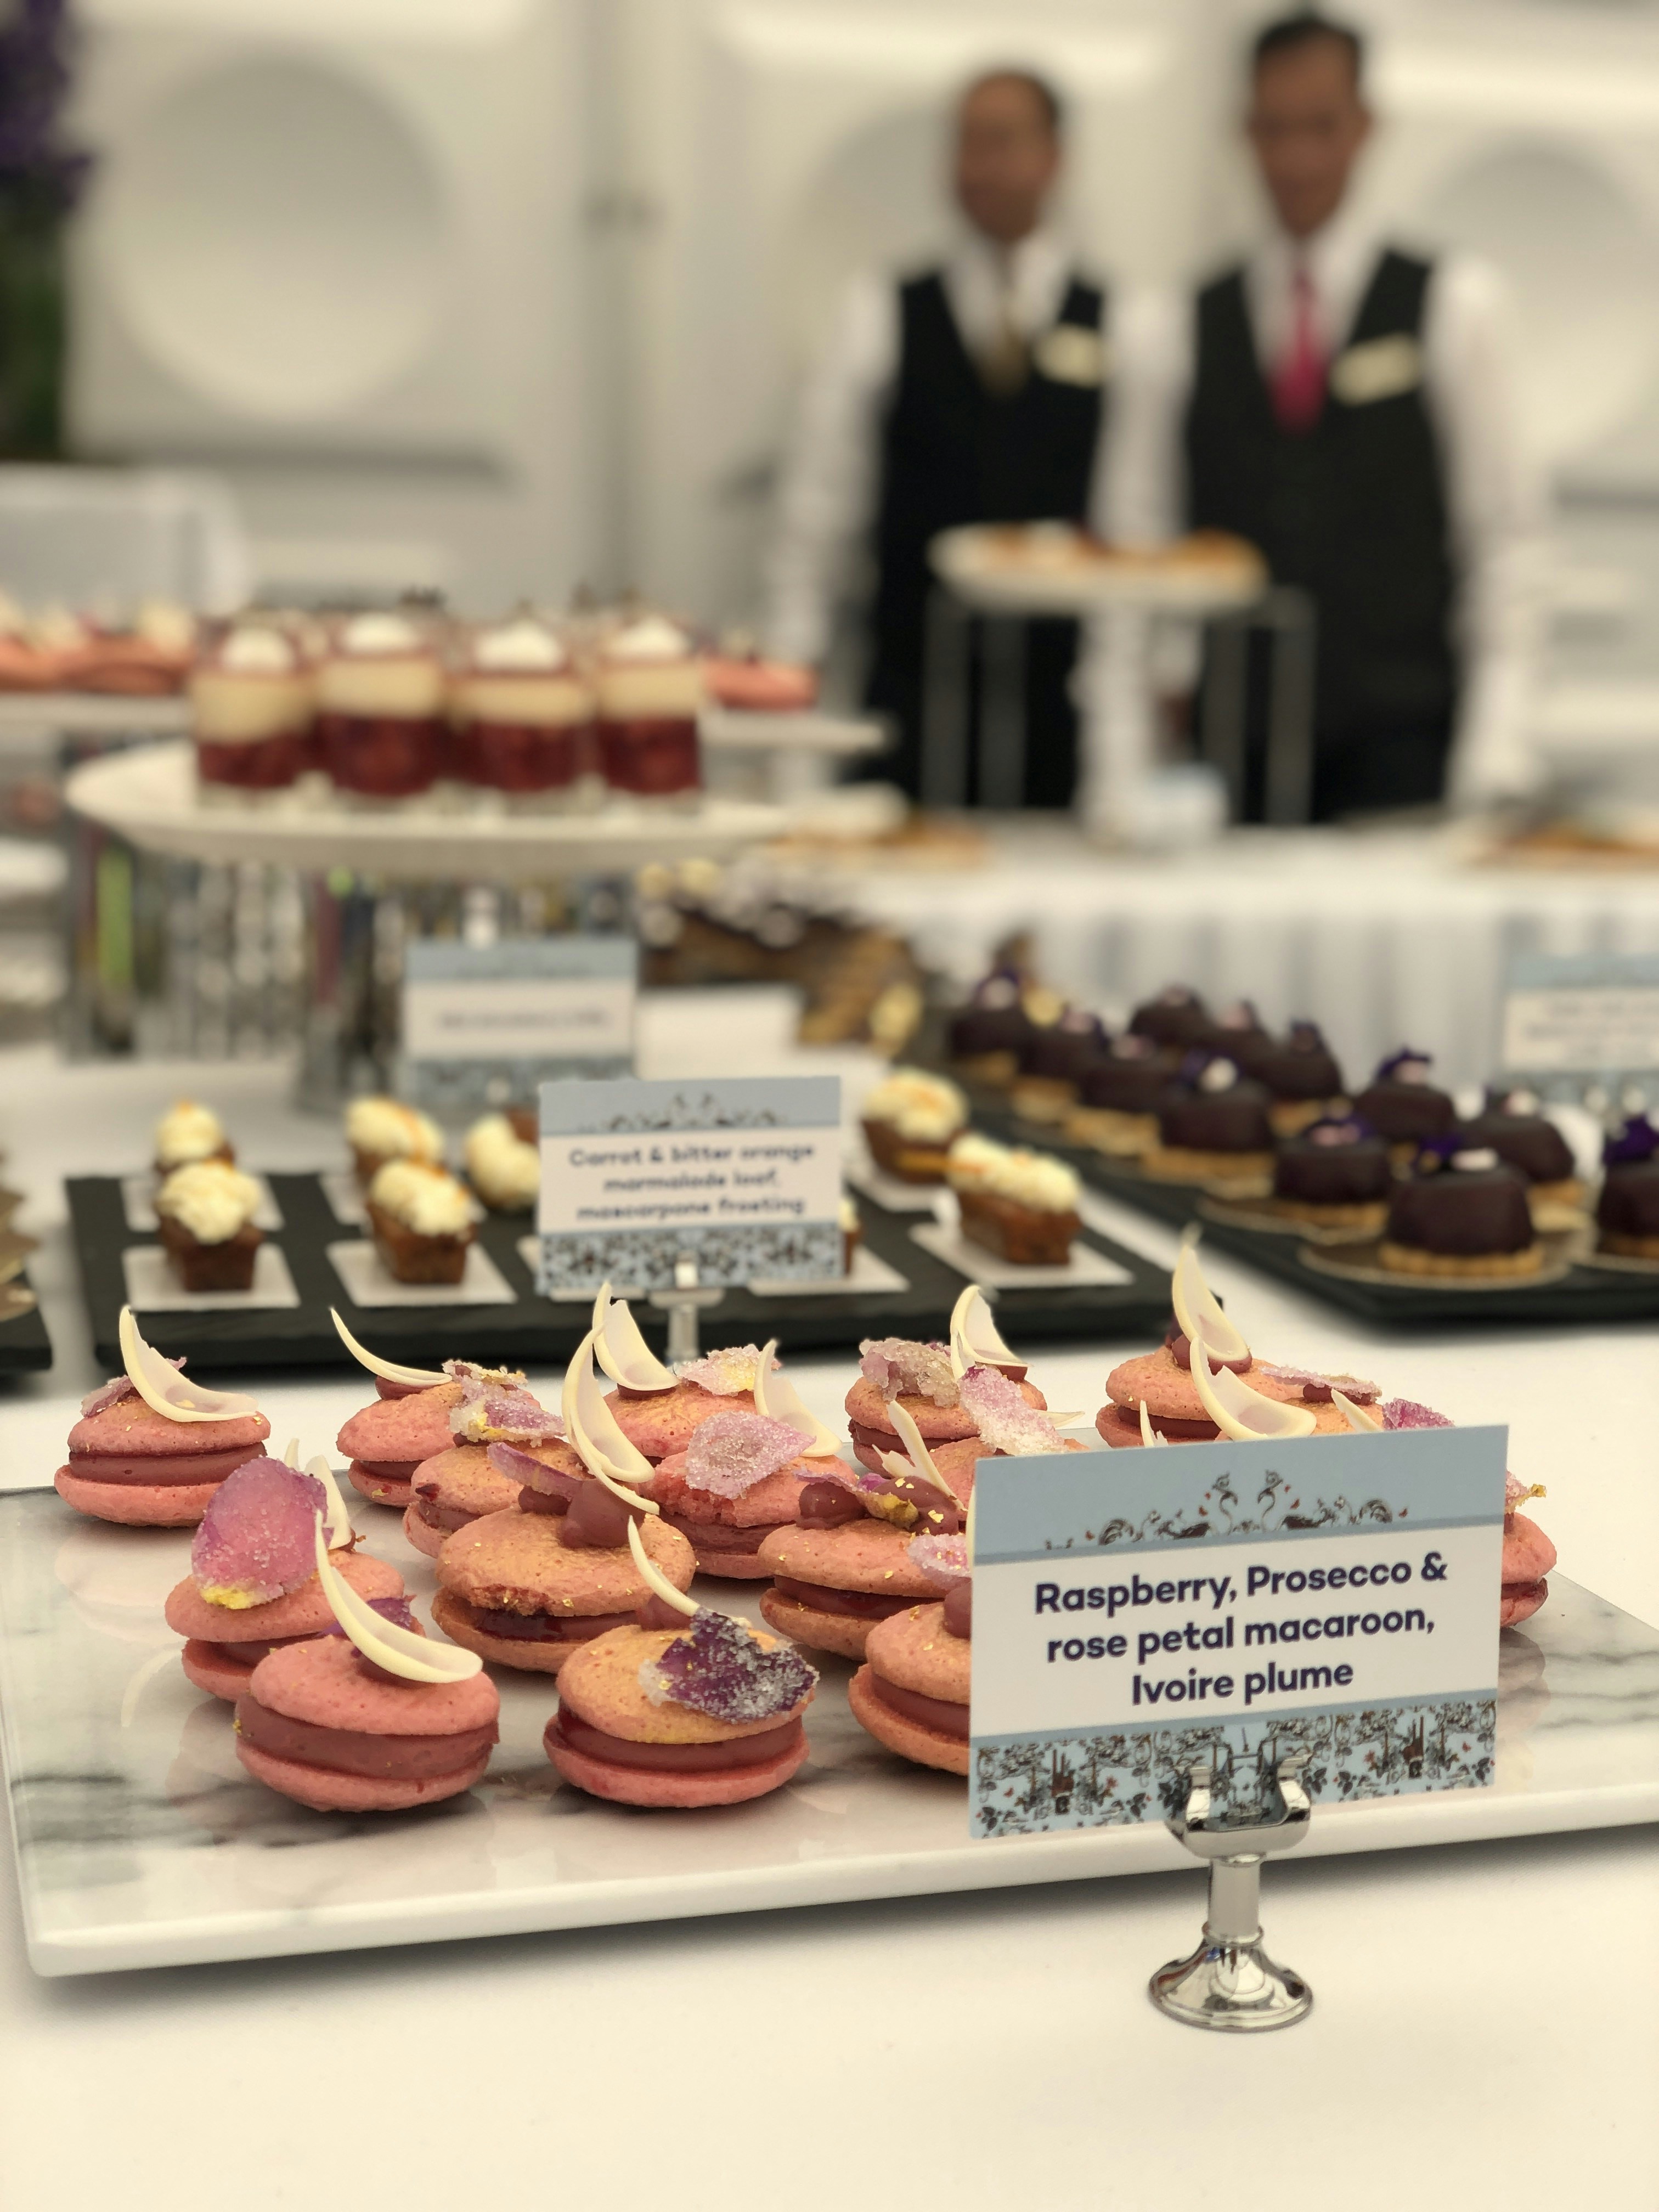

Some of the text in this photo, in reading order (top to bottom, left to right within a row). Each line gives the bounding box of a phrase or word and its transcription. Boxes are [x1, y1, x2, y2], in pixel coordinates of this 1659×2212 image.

[569, 1145, 814, 1166] Carrot & bitter orange
[604, 1169, 727, 1191] marmalade
[719, 1196, 805, 1216] frosting
[1035, 1551, 1448, 1618] Raspberry, Prosecco &
[1047, 1608, 1435, 1665] rose petal macaroon,
[1132, 1661, 1354, 1706] Ivoire plume
